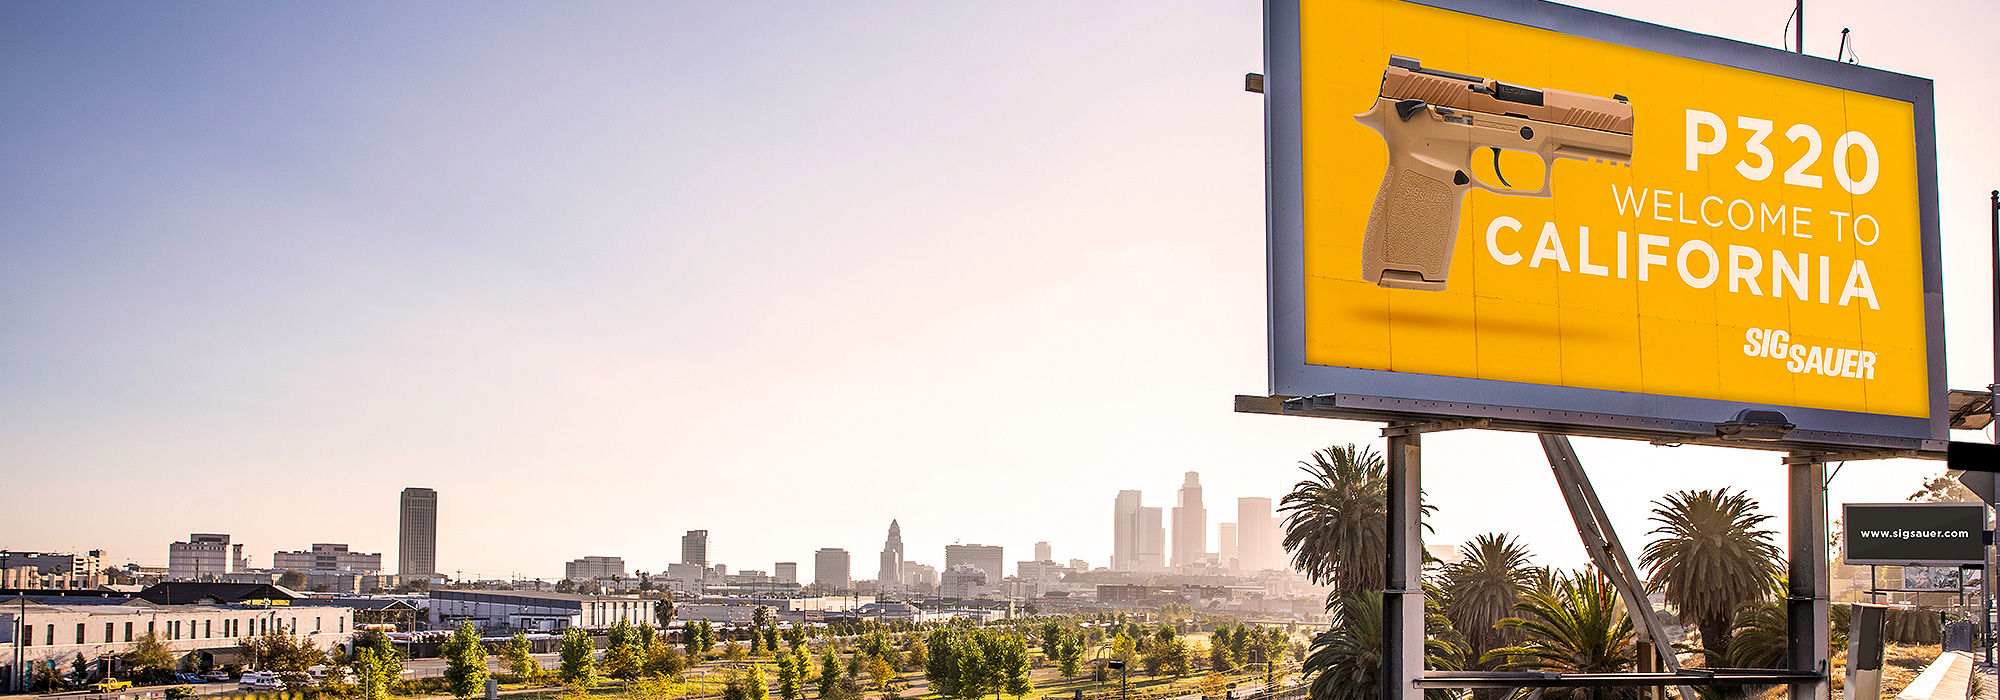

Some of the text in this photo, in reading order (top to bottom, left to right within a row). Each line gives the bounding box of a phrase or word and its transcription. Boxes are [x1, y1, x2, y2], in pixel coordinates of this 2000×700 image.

[1686, 109, 1880, 195] P320
[1612, 184, 1880, 246] WELCOME TO
[1486, 216, 1881, 311] CALIFORNIA
[1860, 528, 1969, 540] www.sigsauer.com
